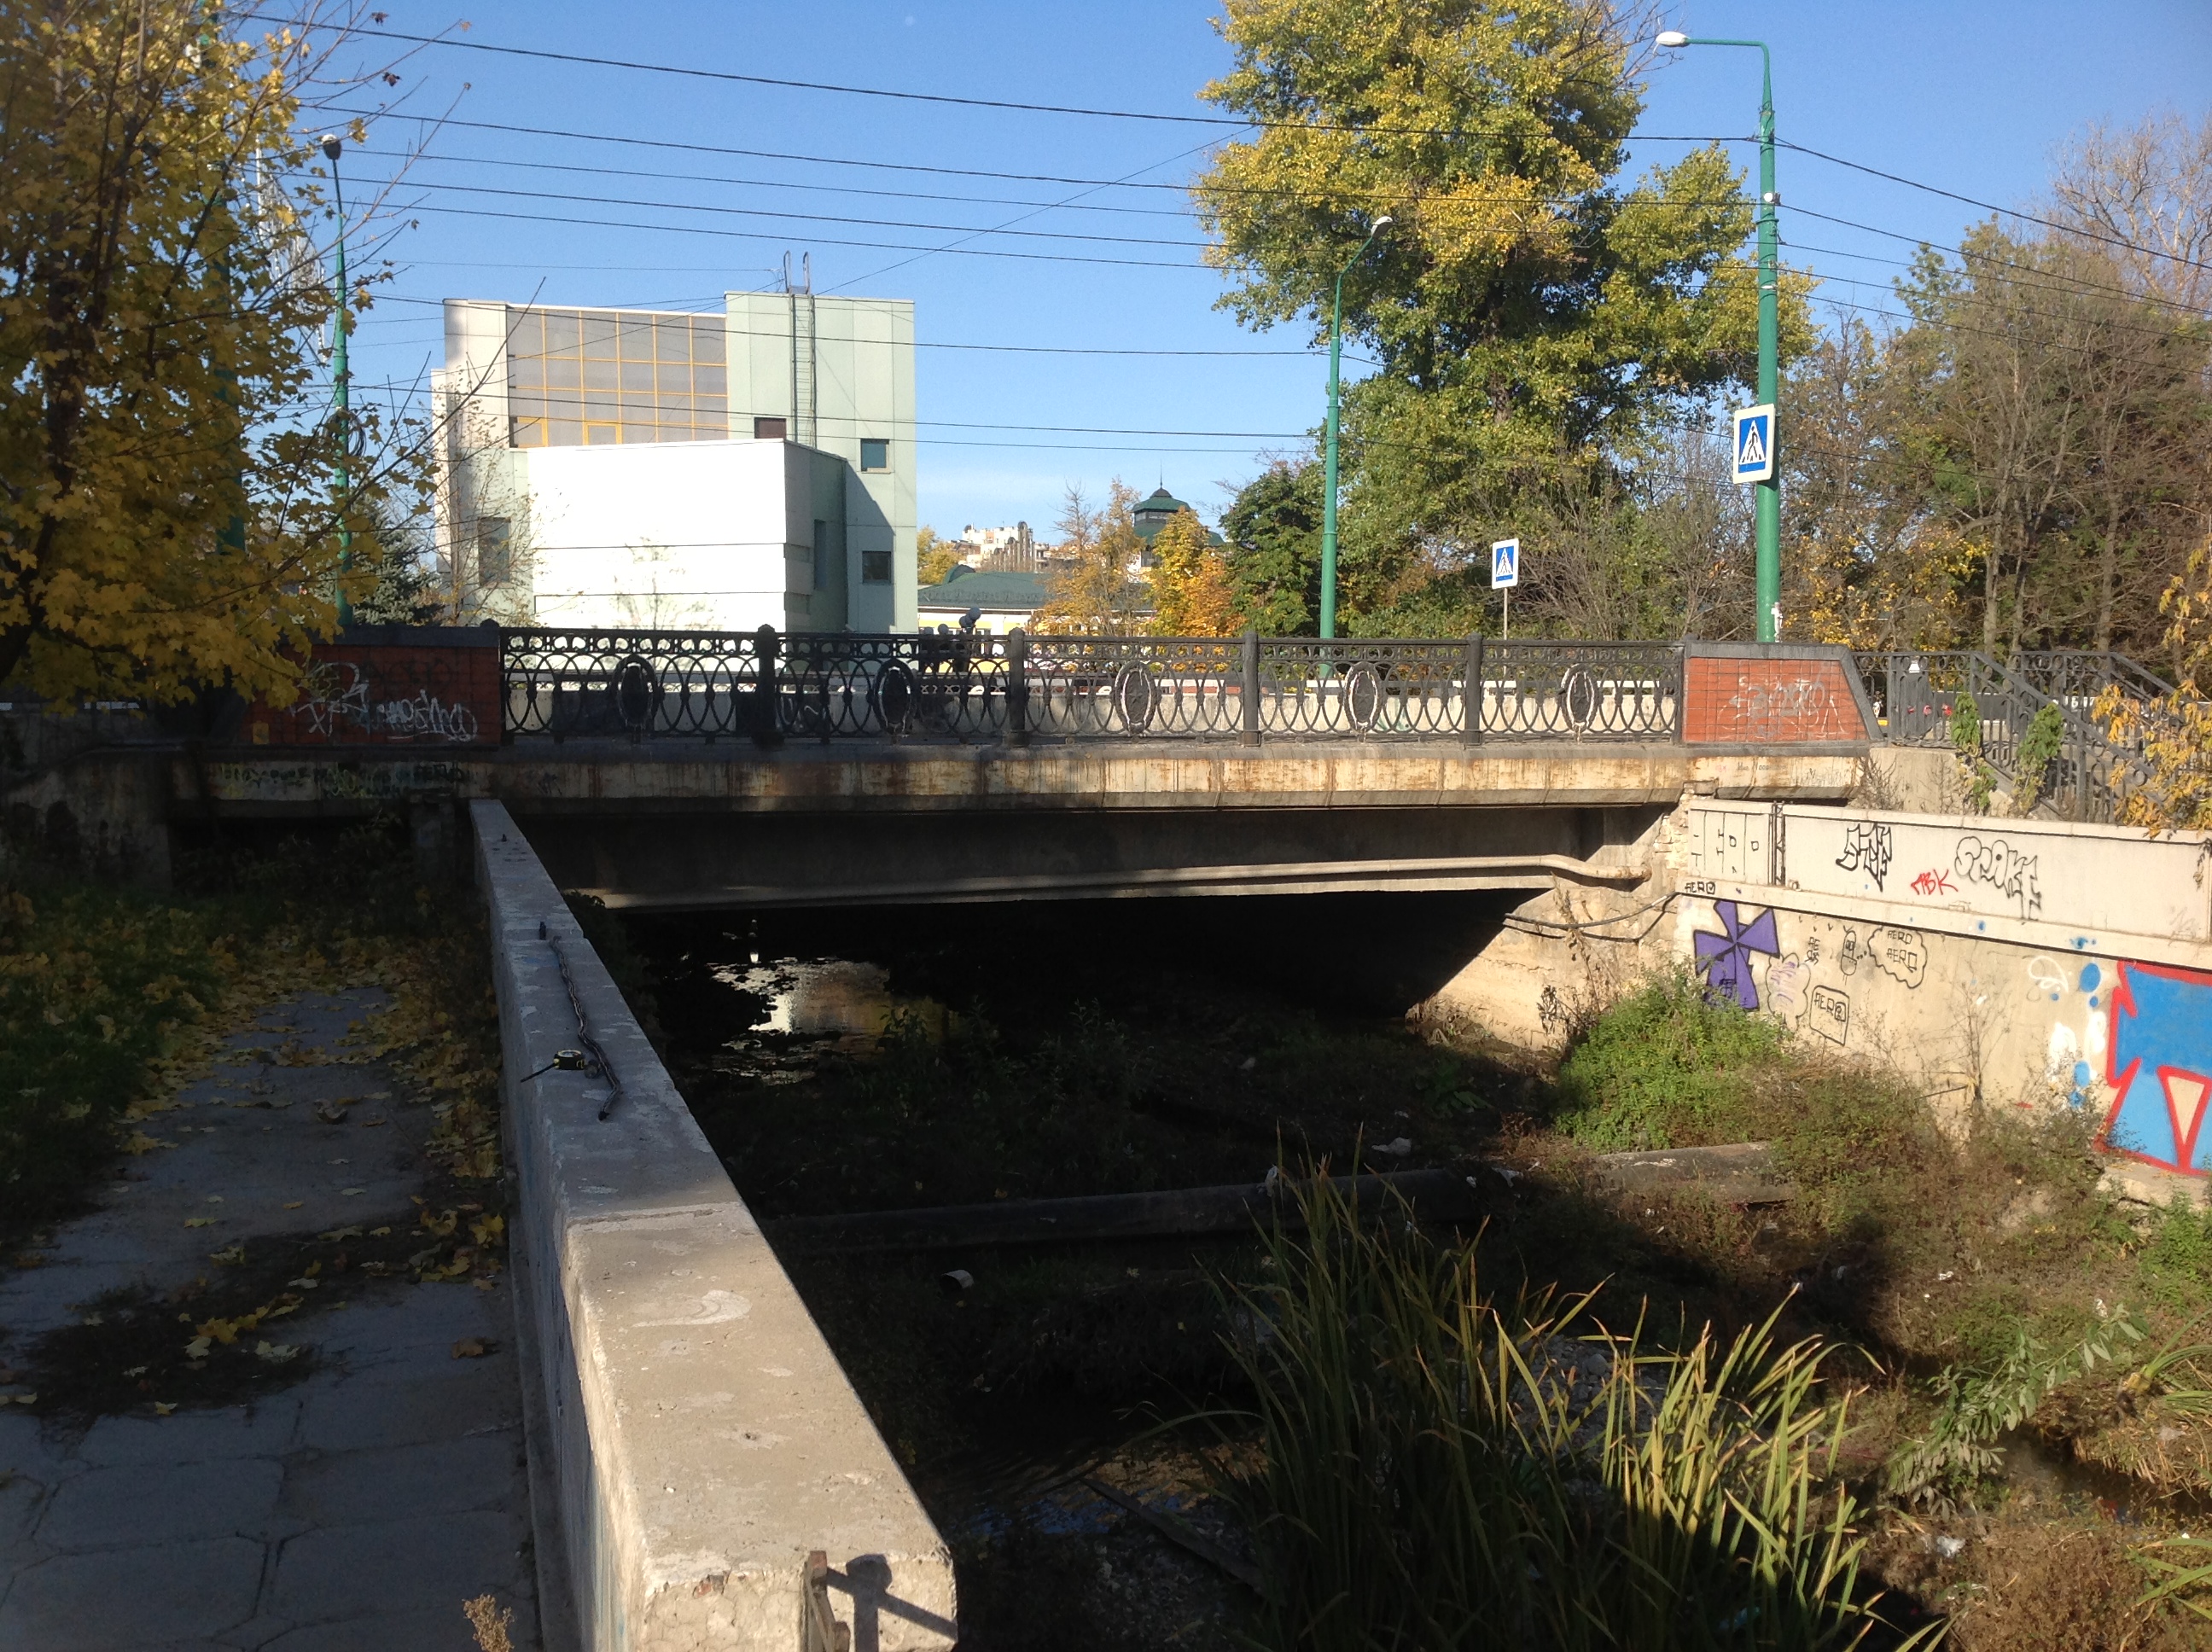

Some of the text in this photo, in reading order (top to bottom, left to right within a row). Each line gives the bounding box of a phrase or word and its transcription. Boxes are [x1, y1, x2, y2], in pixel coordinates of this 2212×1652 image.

[1888, 930, 1912, 945] AERO
[1886, 948, 1918, 973] AERO
[1814, 992, 1847, 1022] AERO
